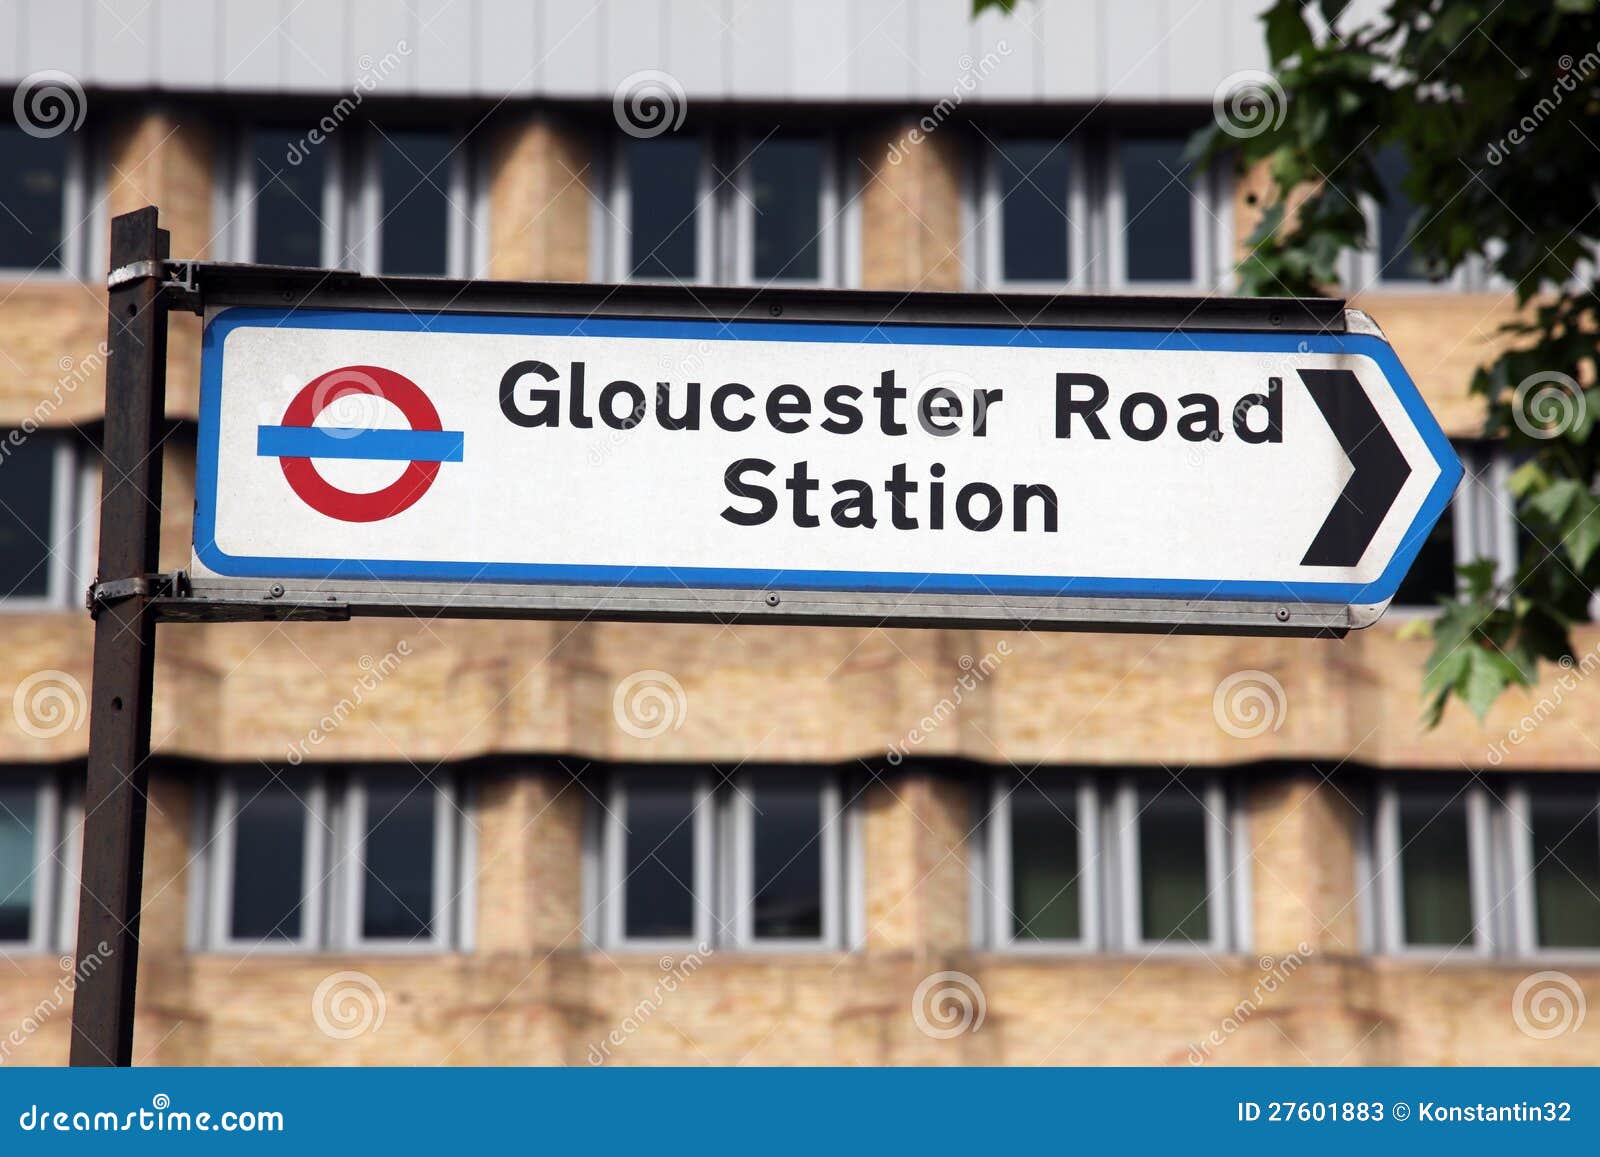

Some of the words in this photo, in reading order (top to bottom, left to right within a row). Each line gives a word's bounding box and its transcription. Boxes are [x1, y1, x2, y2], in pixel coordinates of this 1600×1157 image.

[499, 361, 1002, 437] Gloucester
[1056, 373, 1283, 444] Road
[720, 458, 1058, 533] Station
